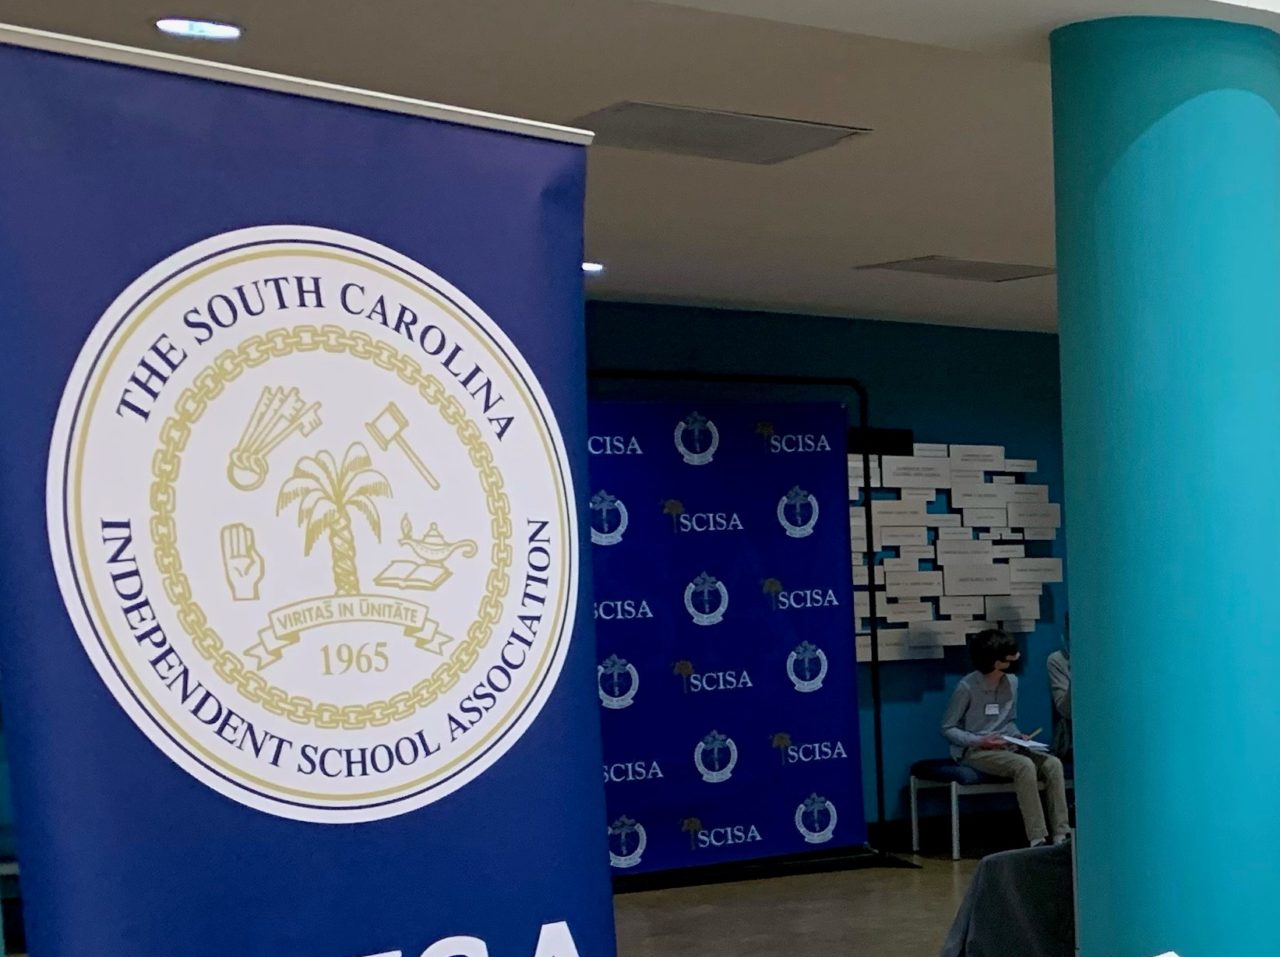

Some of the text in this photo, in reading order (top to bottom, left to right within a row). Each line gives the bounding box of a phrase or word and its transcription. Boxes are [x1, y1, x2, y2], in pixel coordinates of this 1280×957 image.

[116, 275, 517, 442] THE SOUTH CAROLINA
[588, 435, 643, 454] CISA
[770, 434, 831, 453] SCISA
[679, 512, 744, 532] SCISA
[338, 602, 354, 618] IN
[778, 588, 840, 610] SCISA
[100, 518, 552, 779] INDEPENDENT SCHOOL ASSOCIATION
[320, 641, 389, 676] 1965
[690, 670, 753, 692] SCISA
[787, 741, 848, 763] SCISA
[697, 824, 762, 848] SCISA
